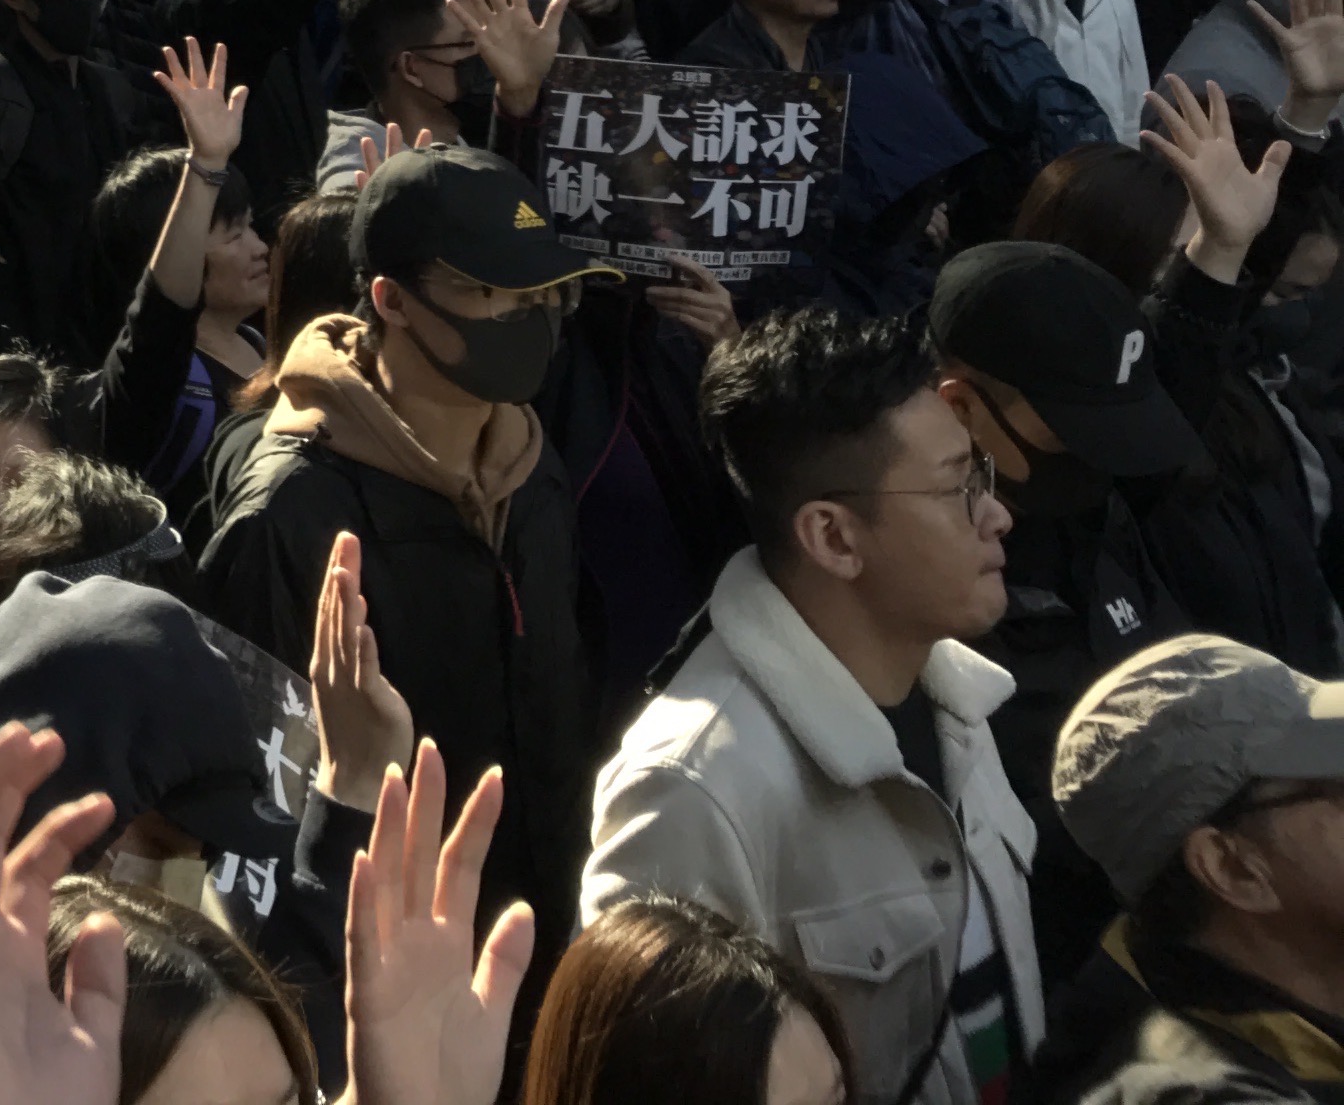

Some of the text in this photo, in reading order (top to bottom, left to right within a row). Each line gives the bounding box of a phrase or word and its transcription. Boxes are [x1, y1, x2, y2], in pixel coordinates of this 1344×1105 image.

[546, 89, 822, 166] 五大訴求
[546, 157, 816, 238] 缺一不可
[1116, 329, 1145, 385] P
